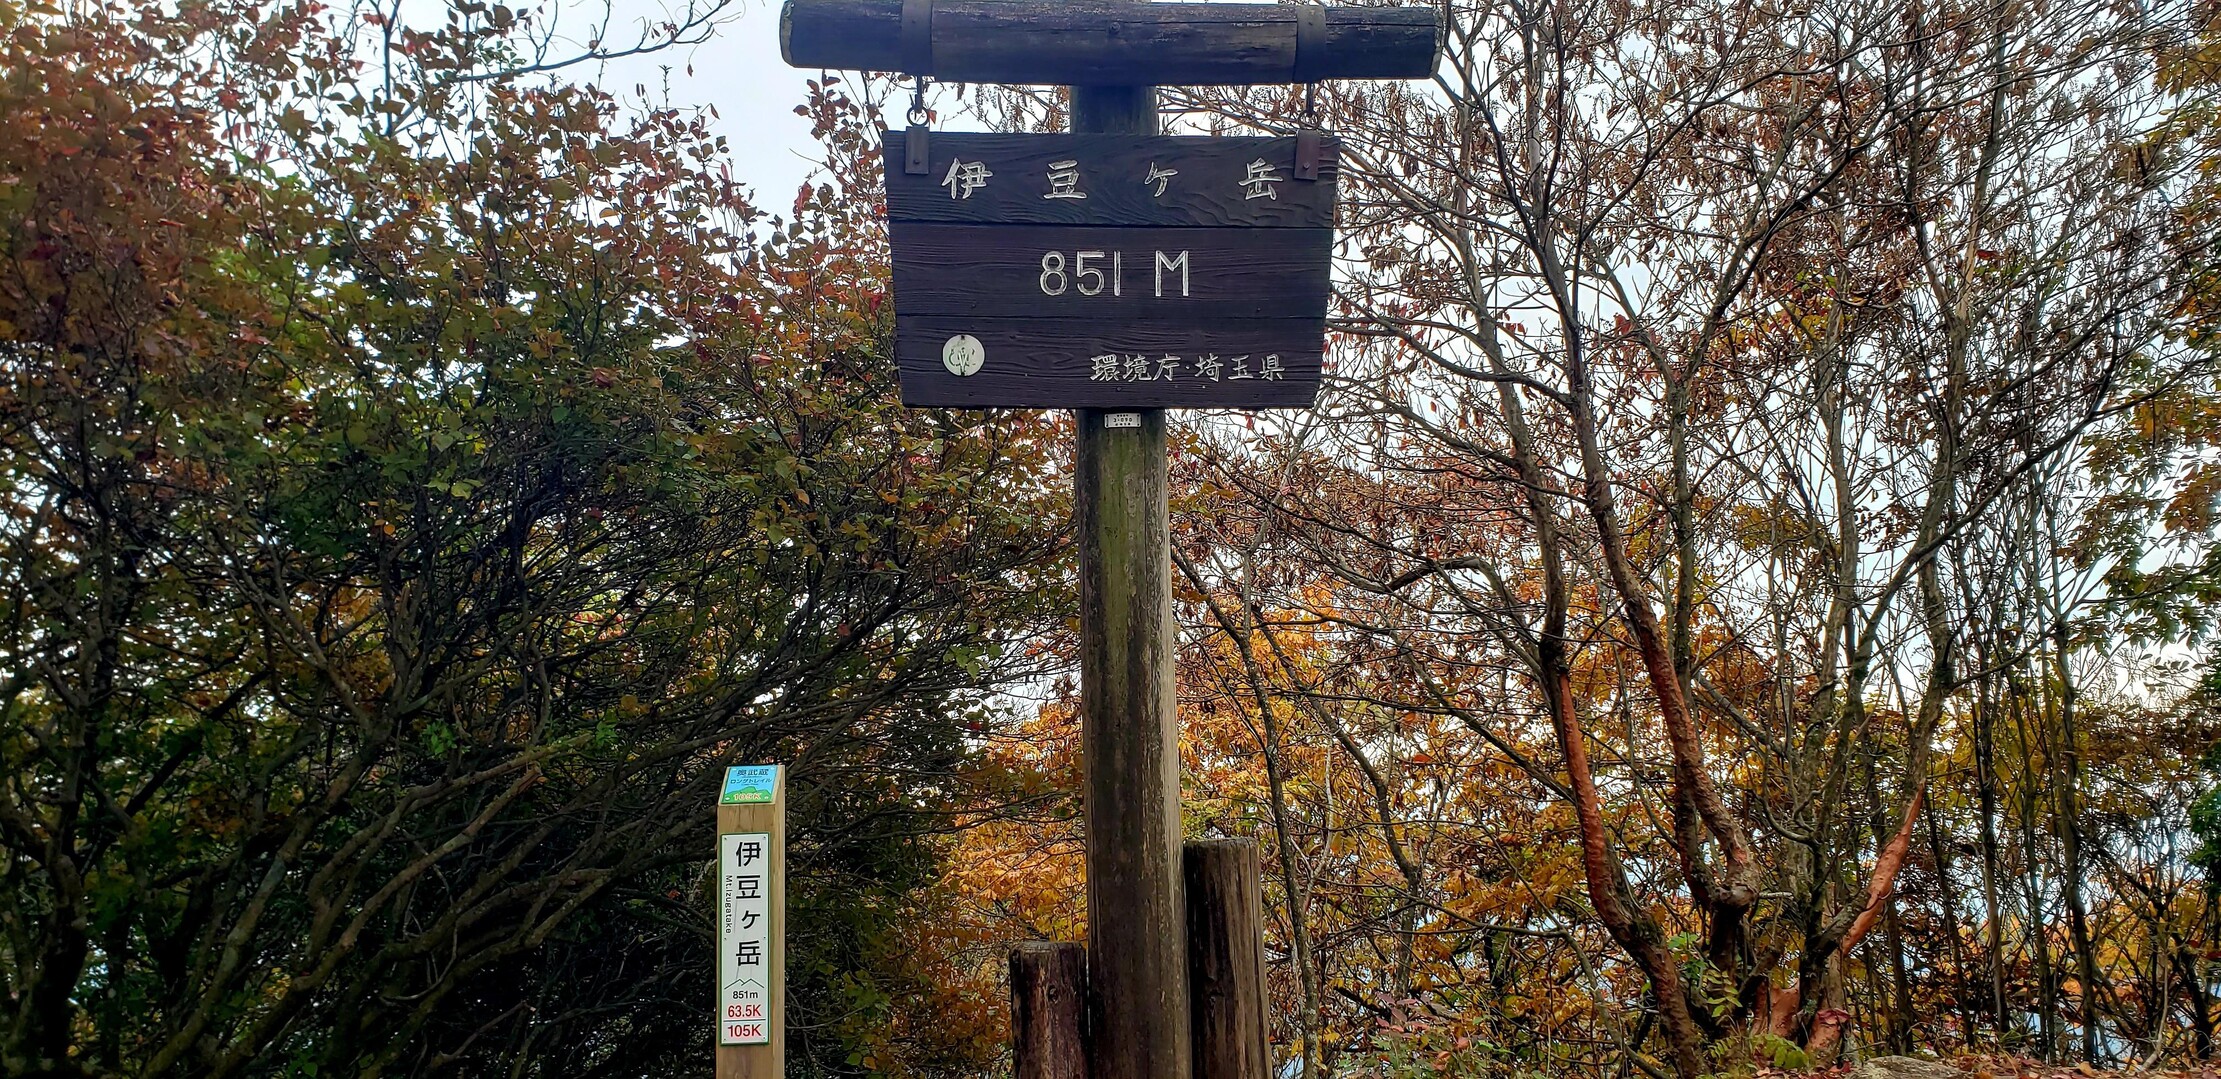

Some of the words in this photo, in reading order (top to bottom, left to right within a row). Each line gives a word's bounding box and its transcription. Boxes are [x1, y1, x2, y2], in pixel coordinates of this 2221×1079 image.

[1039, 251, 1121, 297] 851
[1154, 250, 1190, 297] M
[732, 990, 758, 999] 851m
[728, 1004, 762, 1018] 63.5K
[727, 1024, 762, 1037] 105K
